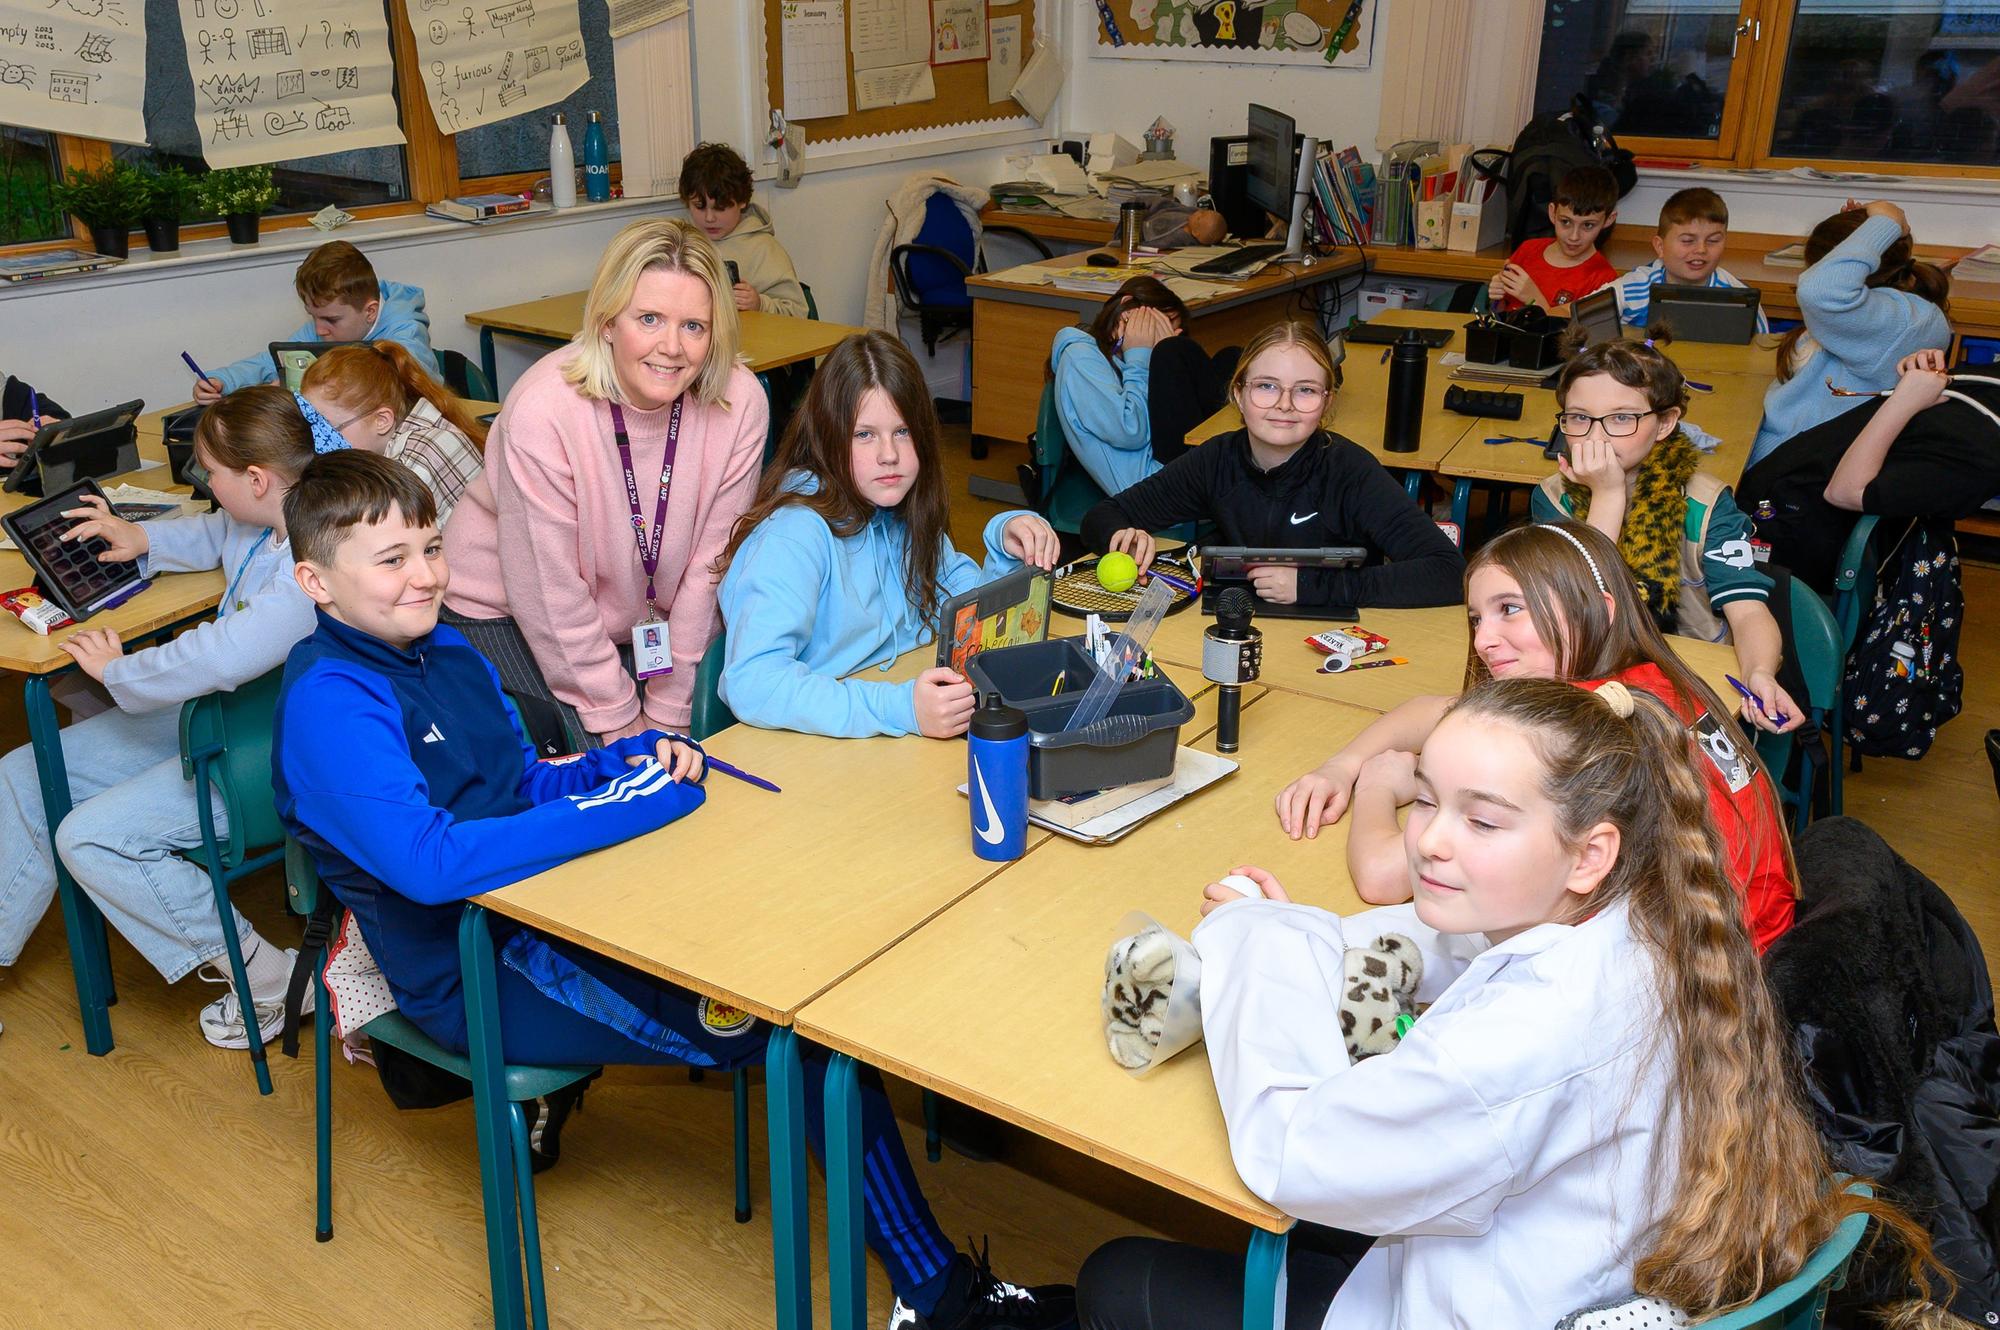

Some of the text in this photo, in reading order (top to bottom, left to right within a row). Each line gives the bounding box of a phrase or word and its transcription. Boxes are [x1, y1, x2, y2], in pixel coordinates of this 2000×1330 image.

[803, 9, 827, 20] January
[0, 23, 28, 45] mpty
[453, 64, 493, 89] furious
[217, 84, 244, 94] BANG
[586, 164, 608, 175] NOAH
[669, 403, 681, 440] FVC STAFF
[625, 469, 638, 505] FVC STAFF
[651, 524, 662, 561] FVC STAFF
